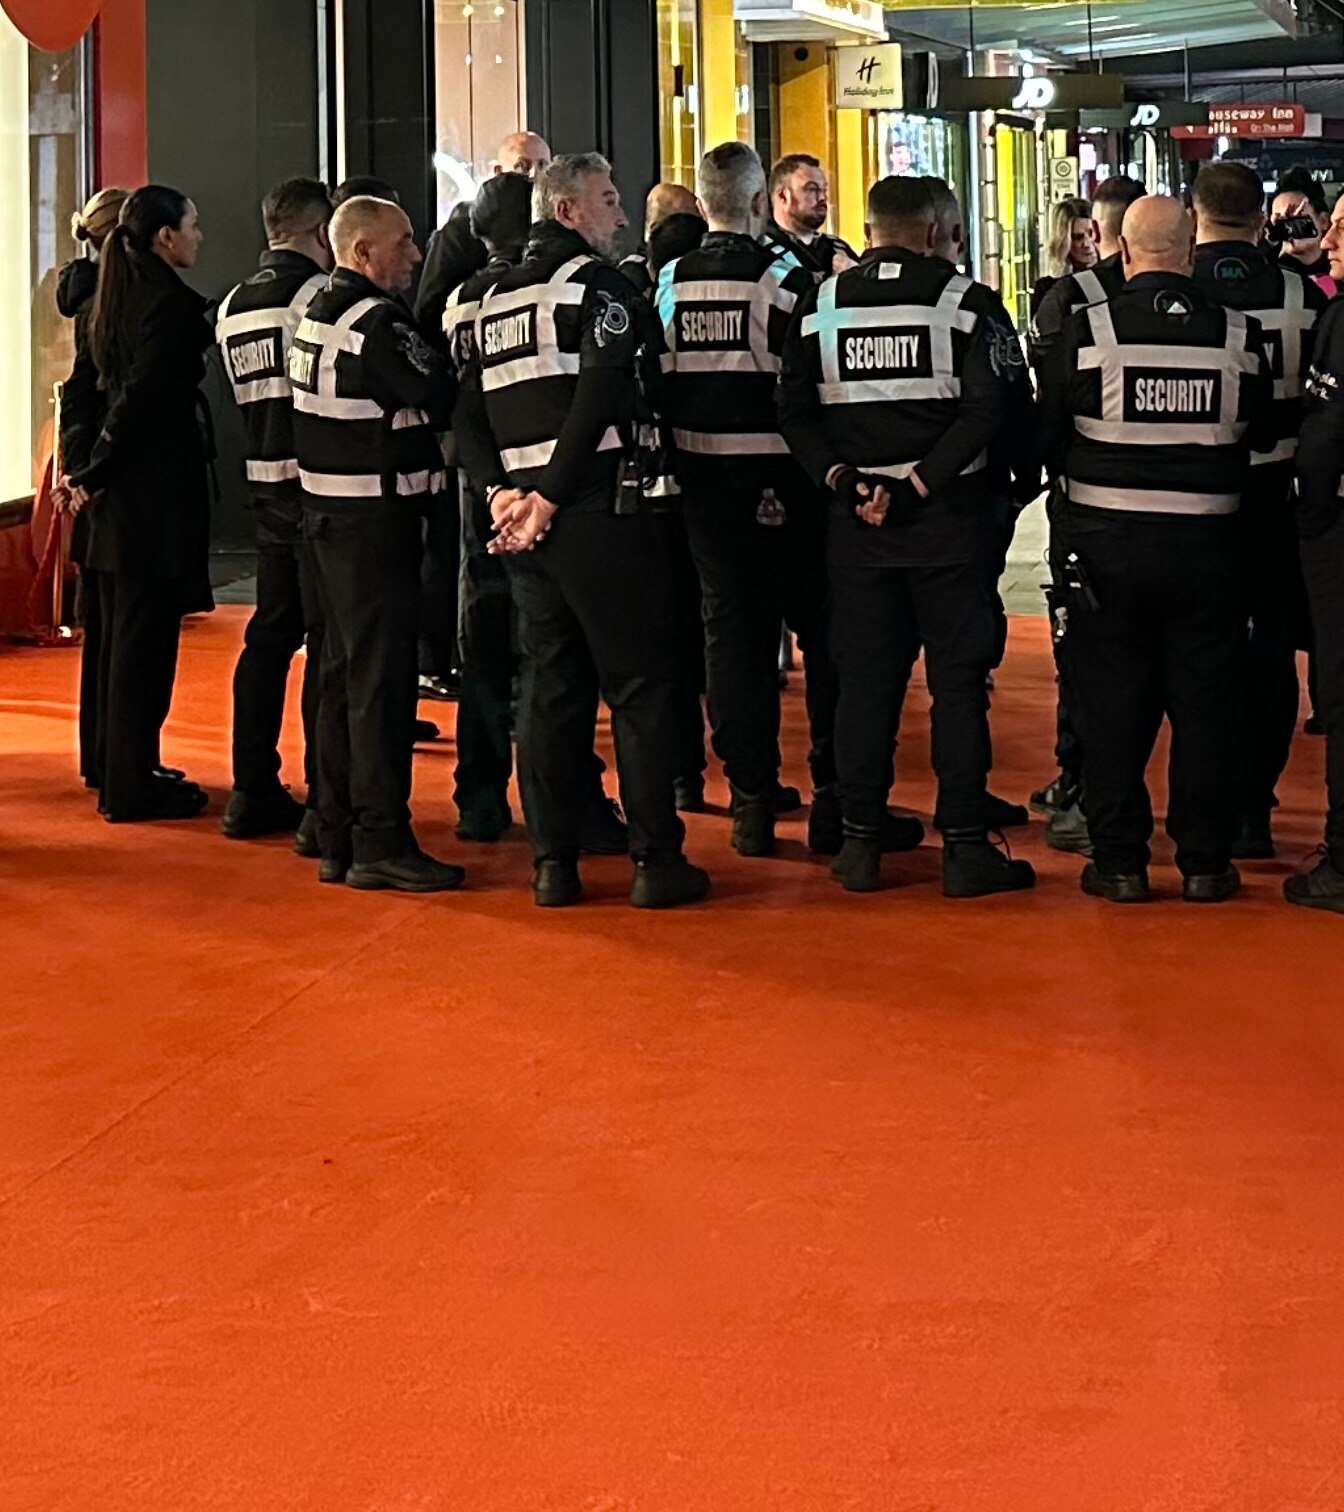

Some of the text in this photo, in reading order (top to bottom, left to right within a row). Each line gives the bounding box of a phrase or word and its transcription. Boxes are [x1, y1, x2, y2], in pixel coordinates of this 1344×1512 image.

[1012, 77, 1054, 108] JD
[1130, 104, 1160, 127] JD
[1272, 107, 1294, 119] Inn
[485, 310, 532, 356] SECURITY
[681, 309, 743, 342] SECURITY
[230, 336, 275, 378] SECURITY
[845, 334, 920, 371] SECURITY
[1135, 377, 1214, 413] SECURITY
